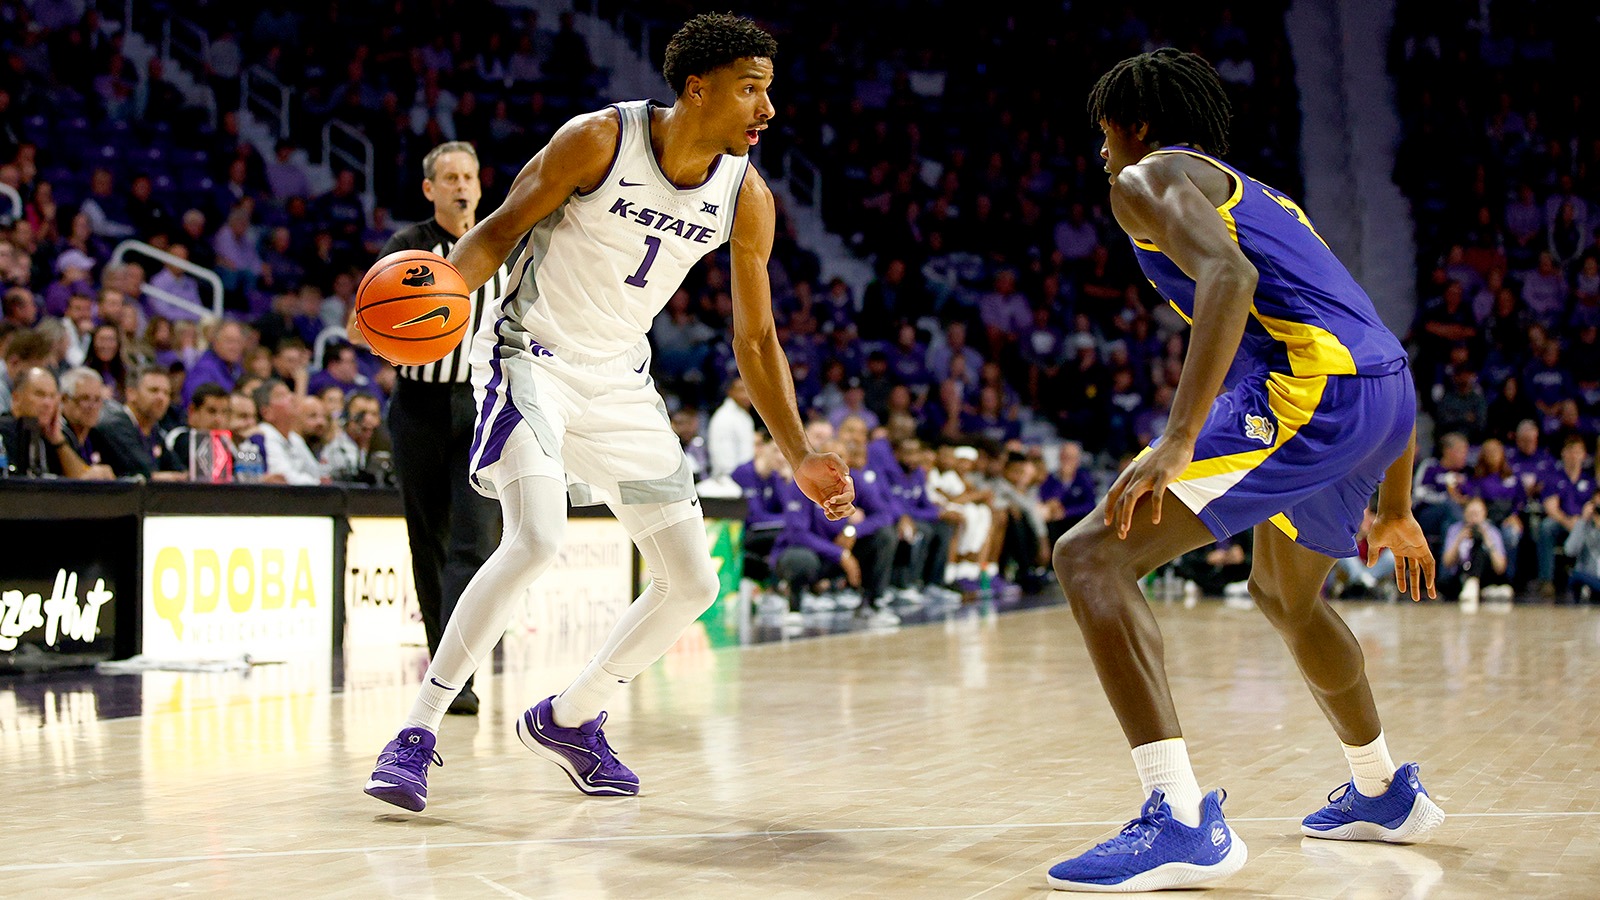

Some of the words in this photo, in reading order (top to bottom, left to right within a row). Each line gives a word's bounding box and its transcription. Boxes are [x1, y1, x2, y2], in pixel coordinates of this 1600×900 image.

[609, 197, 716, 244] K-STATE
[624, 235, 662, 288] 1
[43, 568, 114, 647] Hut
[153, 547, 317, 641] QDOBA
[351, 567, 397, 608] TACO
